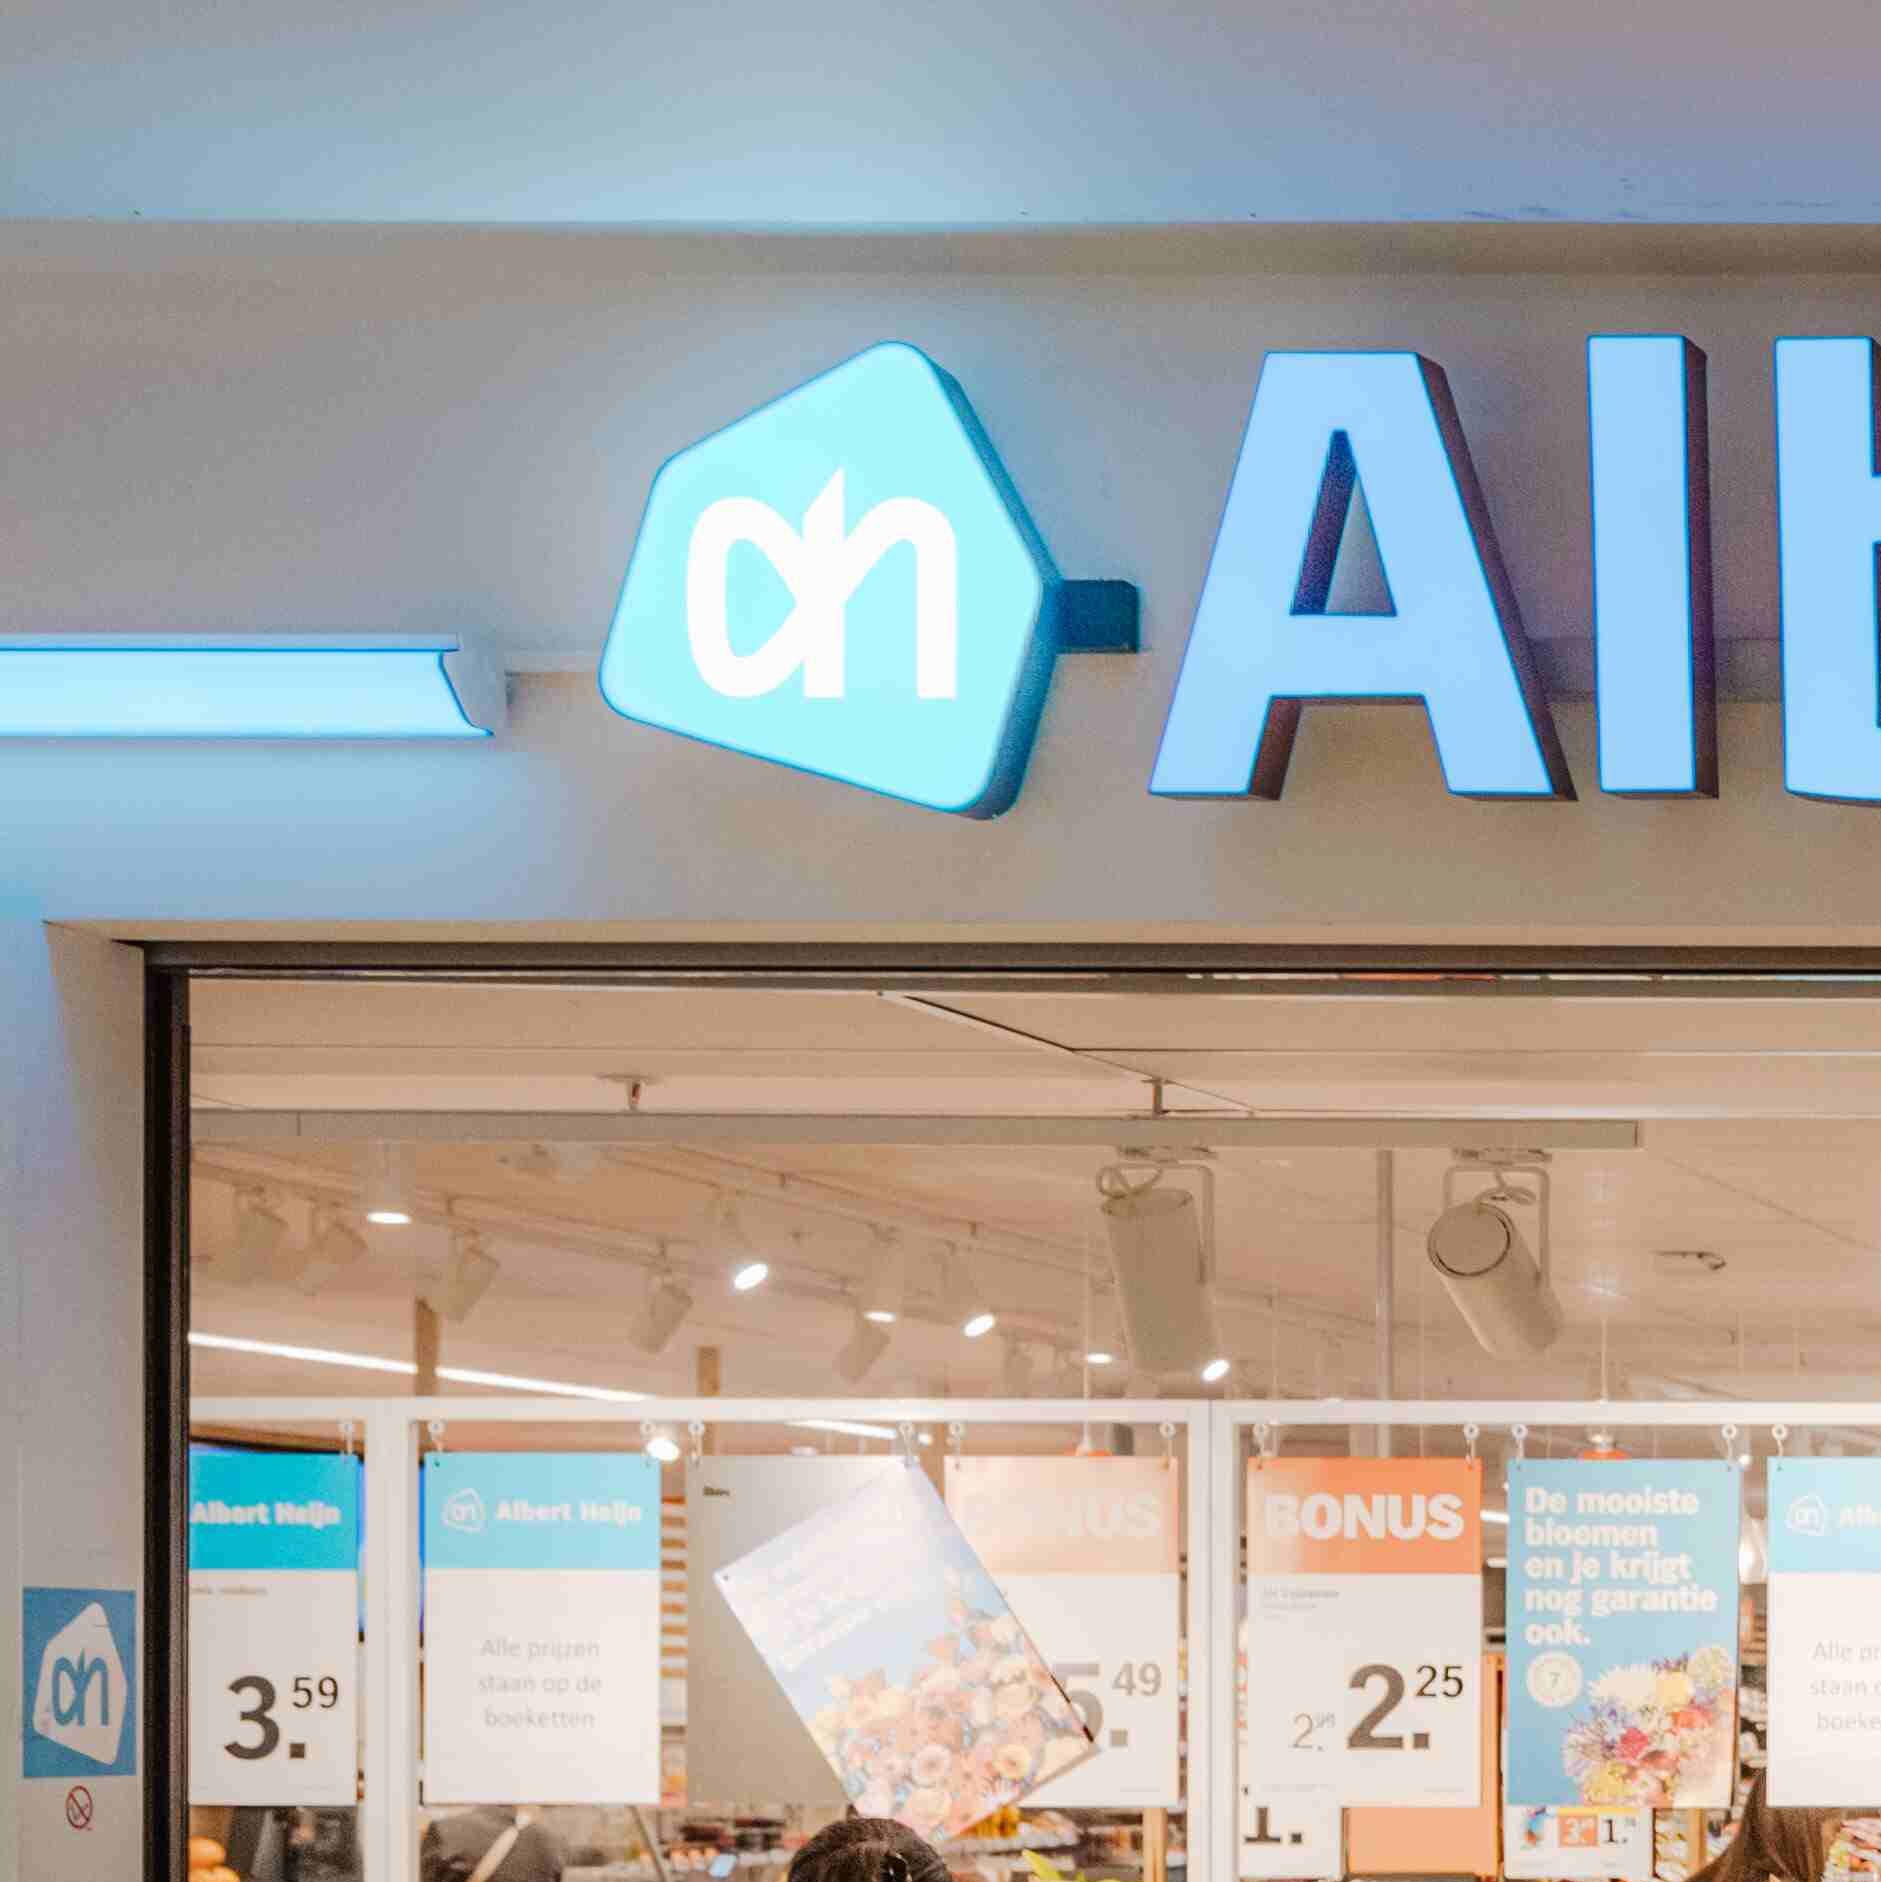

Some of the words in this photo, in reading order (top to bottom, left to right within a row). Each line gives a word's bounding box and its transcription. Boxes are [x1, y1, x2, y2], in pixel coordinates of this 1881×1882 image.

[190, 1501, 270, 1526] Albert
[274, 1500, 342, 1530] Heijn
[496, 1500, 571, 1522] Albert
[580, 1499, 642, 1529] Heijn
[1525, 1487, 1567, 1515] De
[1575, 1487, 1699, 1515] mooiste
[1262, 1493, 1466, 1541] BONUS
[1525, 1517, 1657, 1546] bloemen
[1525, 1556, 1564, 1579] en
[1569, 1551, 1600, 1584] je
[1609, 1551, 1691, 1584] krijgt
[1525, 1588, 1583, 1616] nog
[1590, 1585, 1718, 1616] garantie
[1525, 1617, 1591, 1645] ook.
[480, 1638, 521, 1660] Alle
[526, 1638, 600, 1665] prijzen
[1810, 1640, 1853, 1664] Alle
[478, 1673, 534, 1695] staan
[541, 1675, 569, 1699] op
[576, 1673, 604, 1694] de
[1809, 1677, 1869, 1697] staan
[484, 1707, 596, 1730] boeketten
